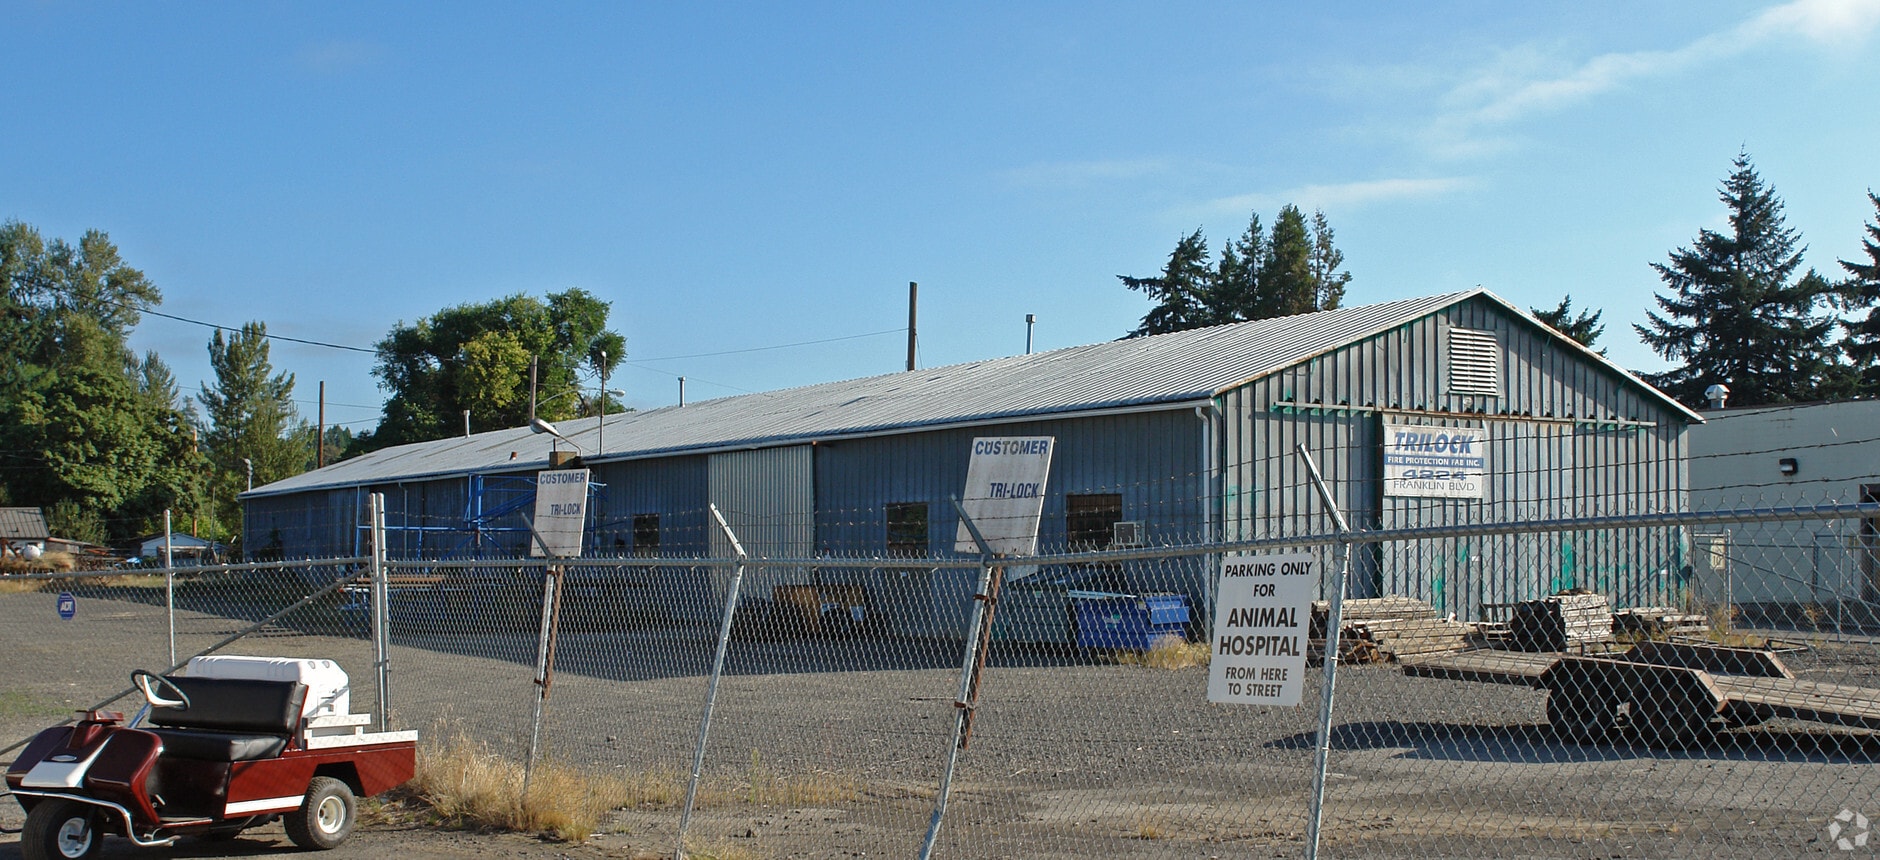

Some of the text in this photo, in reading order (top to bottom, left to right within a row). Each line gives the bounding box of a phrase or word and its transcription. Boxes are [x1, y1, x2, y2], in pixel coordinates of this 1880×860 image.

[975, 440, 1048, 455] CUSTOMER
[1394, 432, 1475, 454] TRILOCK
[1387, 456, 1403, 464] FIRE
[1405, 456, 1449, 465] PROTECTION
[1466, 458, 1480, 467] INC.
[539, 472, 586, 485] CUSTOMER
[1402, 469, 1467, 481] 4224
[990, 482, 1039, 498] TRI-LOCK
[1393, 480, 1445, 490] FRANKLIN
[550, 502, 582, 515] TRI-LOCK
[1224, 561, 1313, 578] PARKING ONLY
[1253, 583, 1275, 597] FOR
[60, 601, 73, 611] ADT
[1226, 607, 1298, 628] ANIMAL
[1219, 635, 1300, 657] HOSPITAL
[1225, 667, 1288, 681] FROM HERE
[1228, 683, 1283, 698] TO STREET
